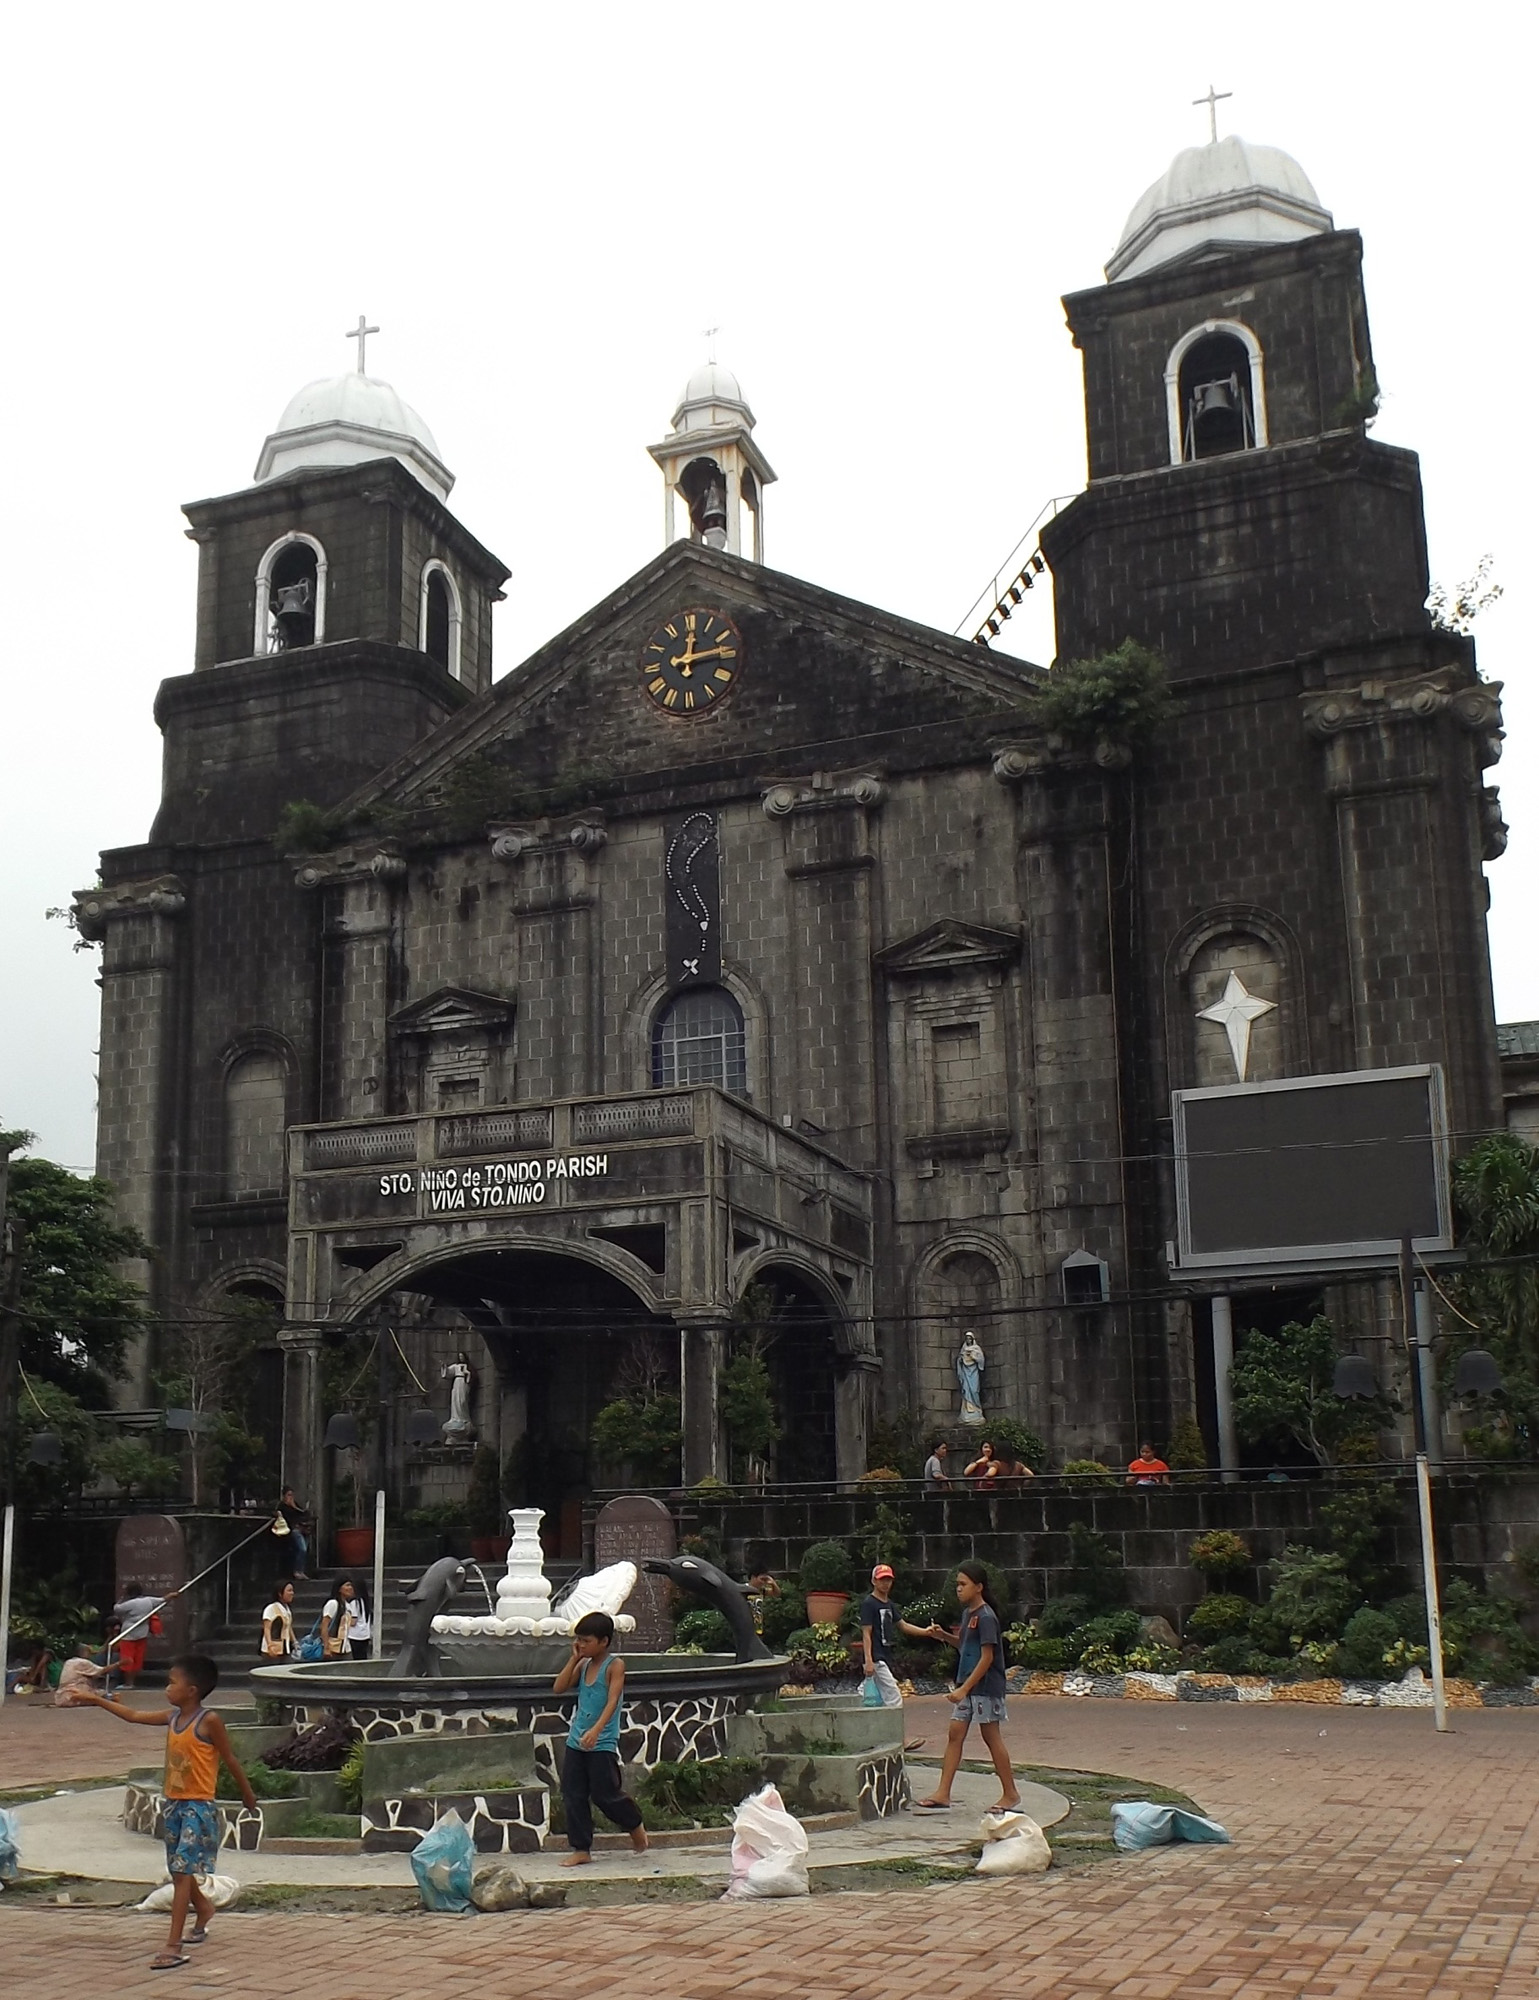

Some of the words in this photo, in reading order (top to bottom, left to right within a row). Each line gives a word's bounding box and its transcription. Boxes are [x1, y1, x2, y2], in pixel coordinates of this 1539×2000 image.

[380, 1173, 415, 1196] STO.
[420, 1168, 457, 1191] NIÑO
[462, 1167, 481, 1188] de
[484, 1160, 542, 1184] TONDO
[546, 1154, 608, 1179] PARISH
[431, 1188, 465, 1210] VIVA
